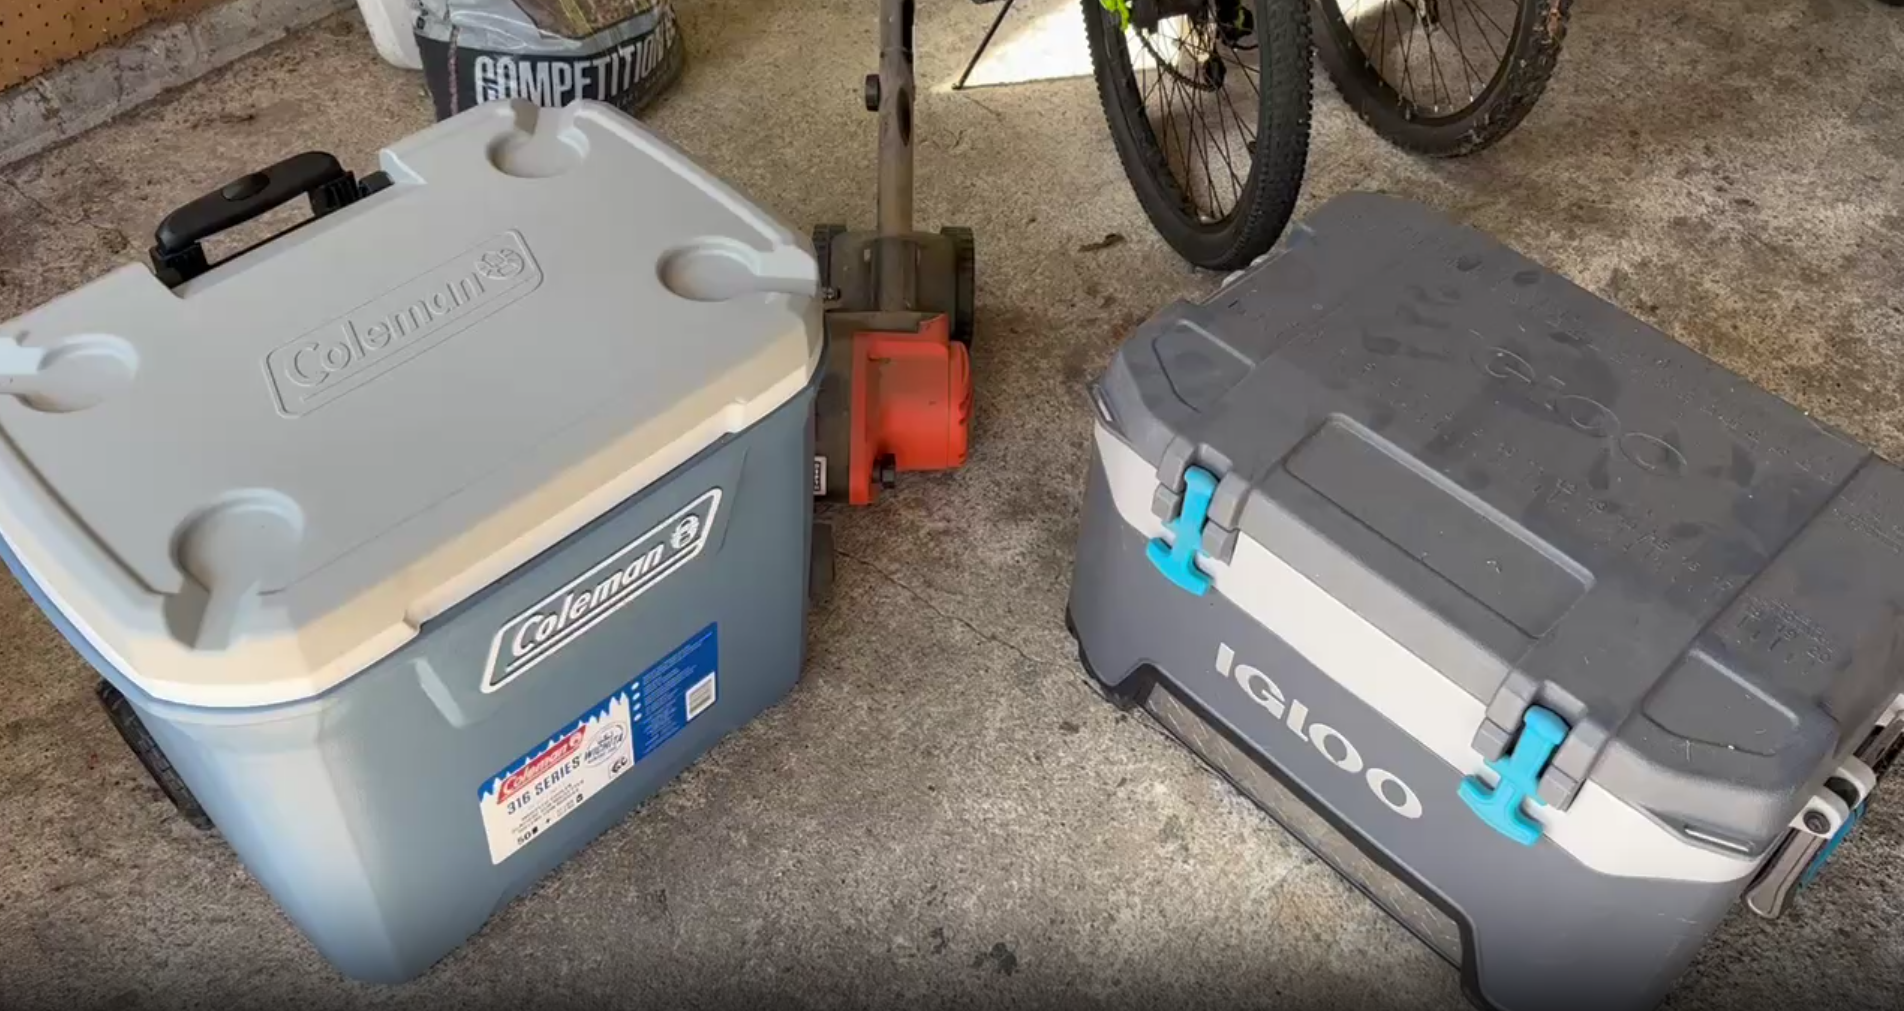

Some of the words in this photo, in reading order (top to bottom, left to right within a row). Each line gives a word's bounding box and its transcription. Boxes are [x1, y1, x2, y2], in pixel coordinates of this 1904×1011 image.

[475, 24, 664, 107] COMPETITION
[285, 270, 485, 387] Coleman
[512, 543, 666, 657] Coleman
[503, 742, 569, 795] Coleman
[1215, 641, 1424, 819] IGLOO
[507, 790, 531, 815] 316
[535, 756, 580, 796] SERIES
